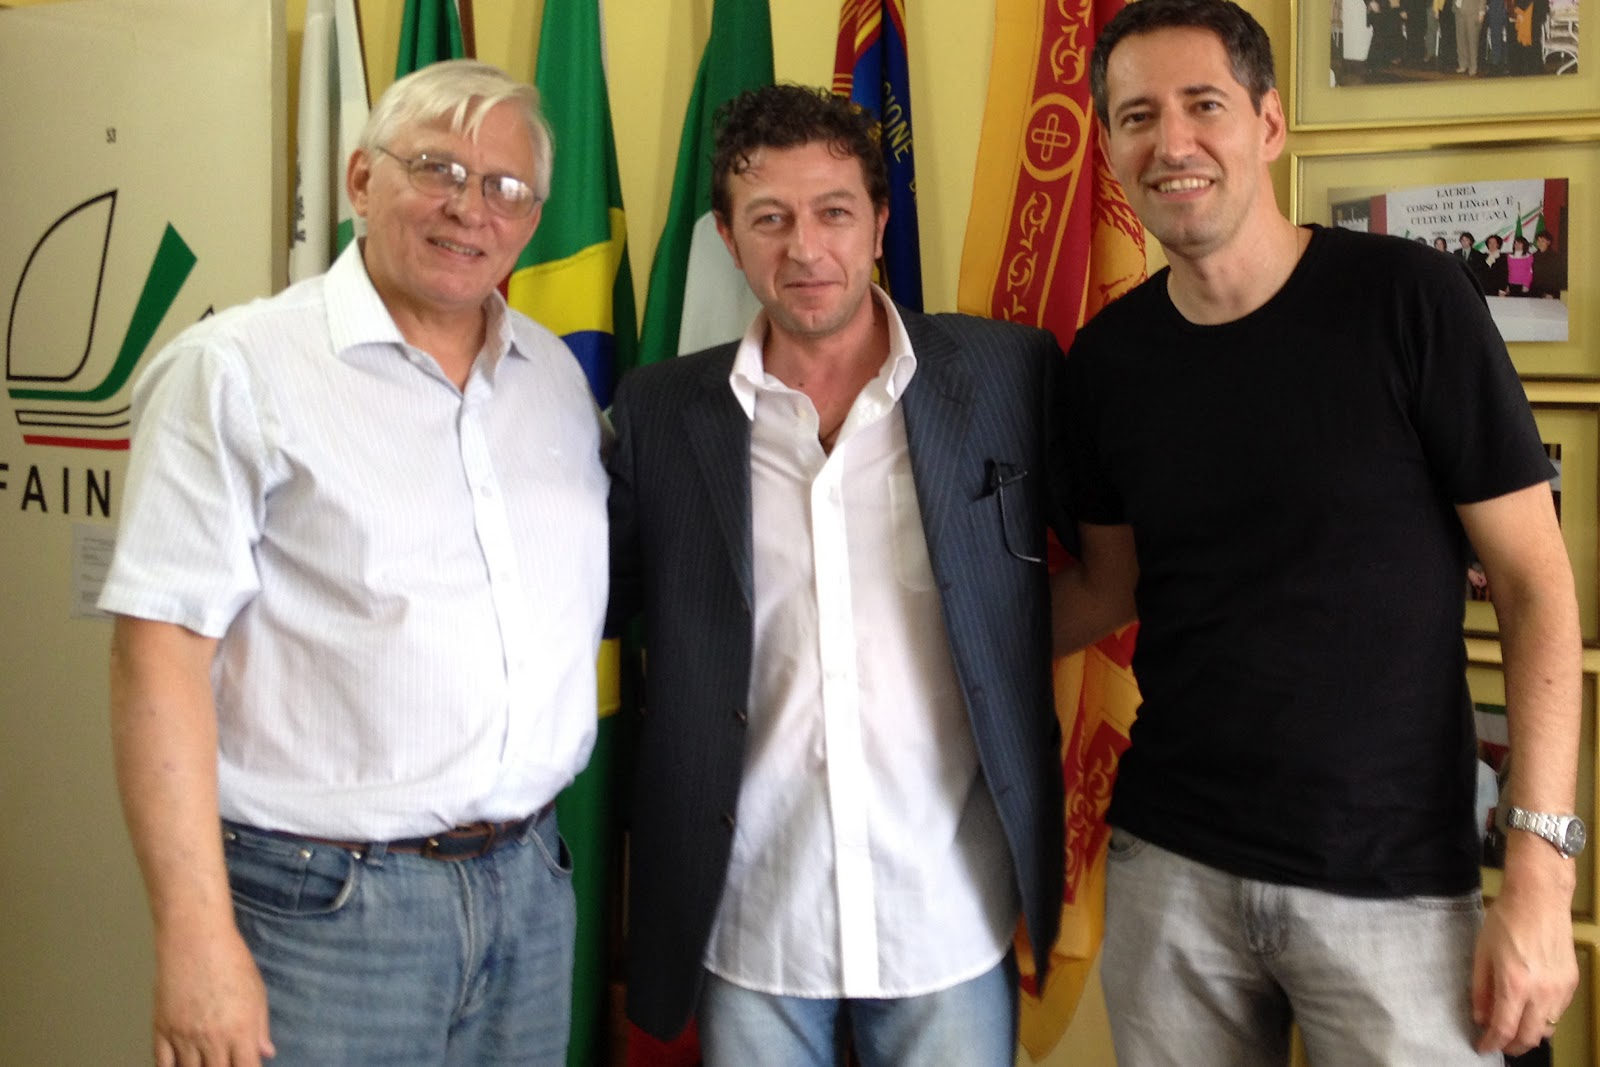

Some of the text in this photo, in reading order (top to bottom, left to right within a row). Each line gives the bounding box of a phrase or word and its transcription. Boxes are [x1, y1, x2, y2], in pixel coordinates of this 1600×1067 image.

[1437, 187, 1476, 198] LAUREA
[1407, 203, 1438, 213] CORSO
[1443, 201, 1454, 210] DI
[1459, 198, 1499, 209] LINGUA
[1411, 215, 1453, 225] CULTURA
